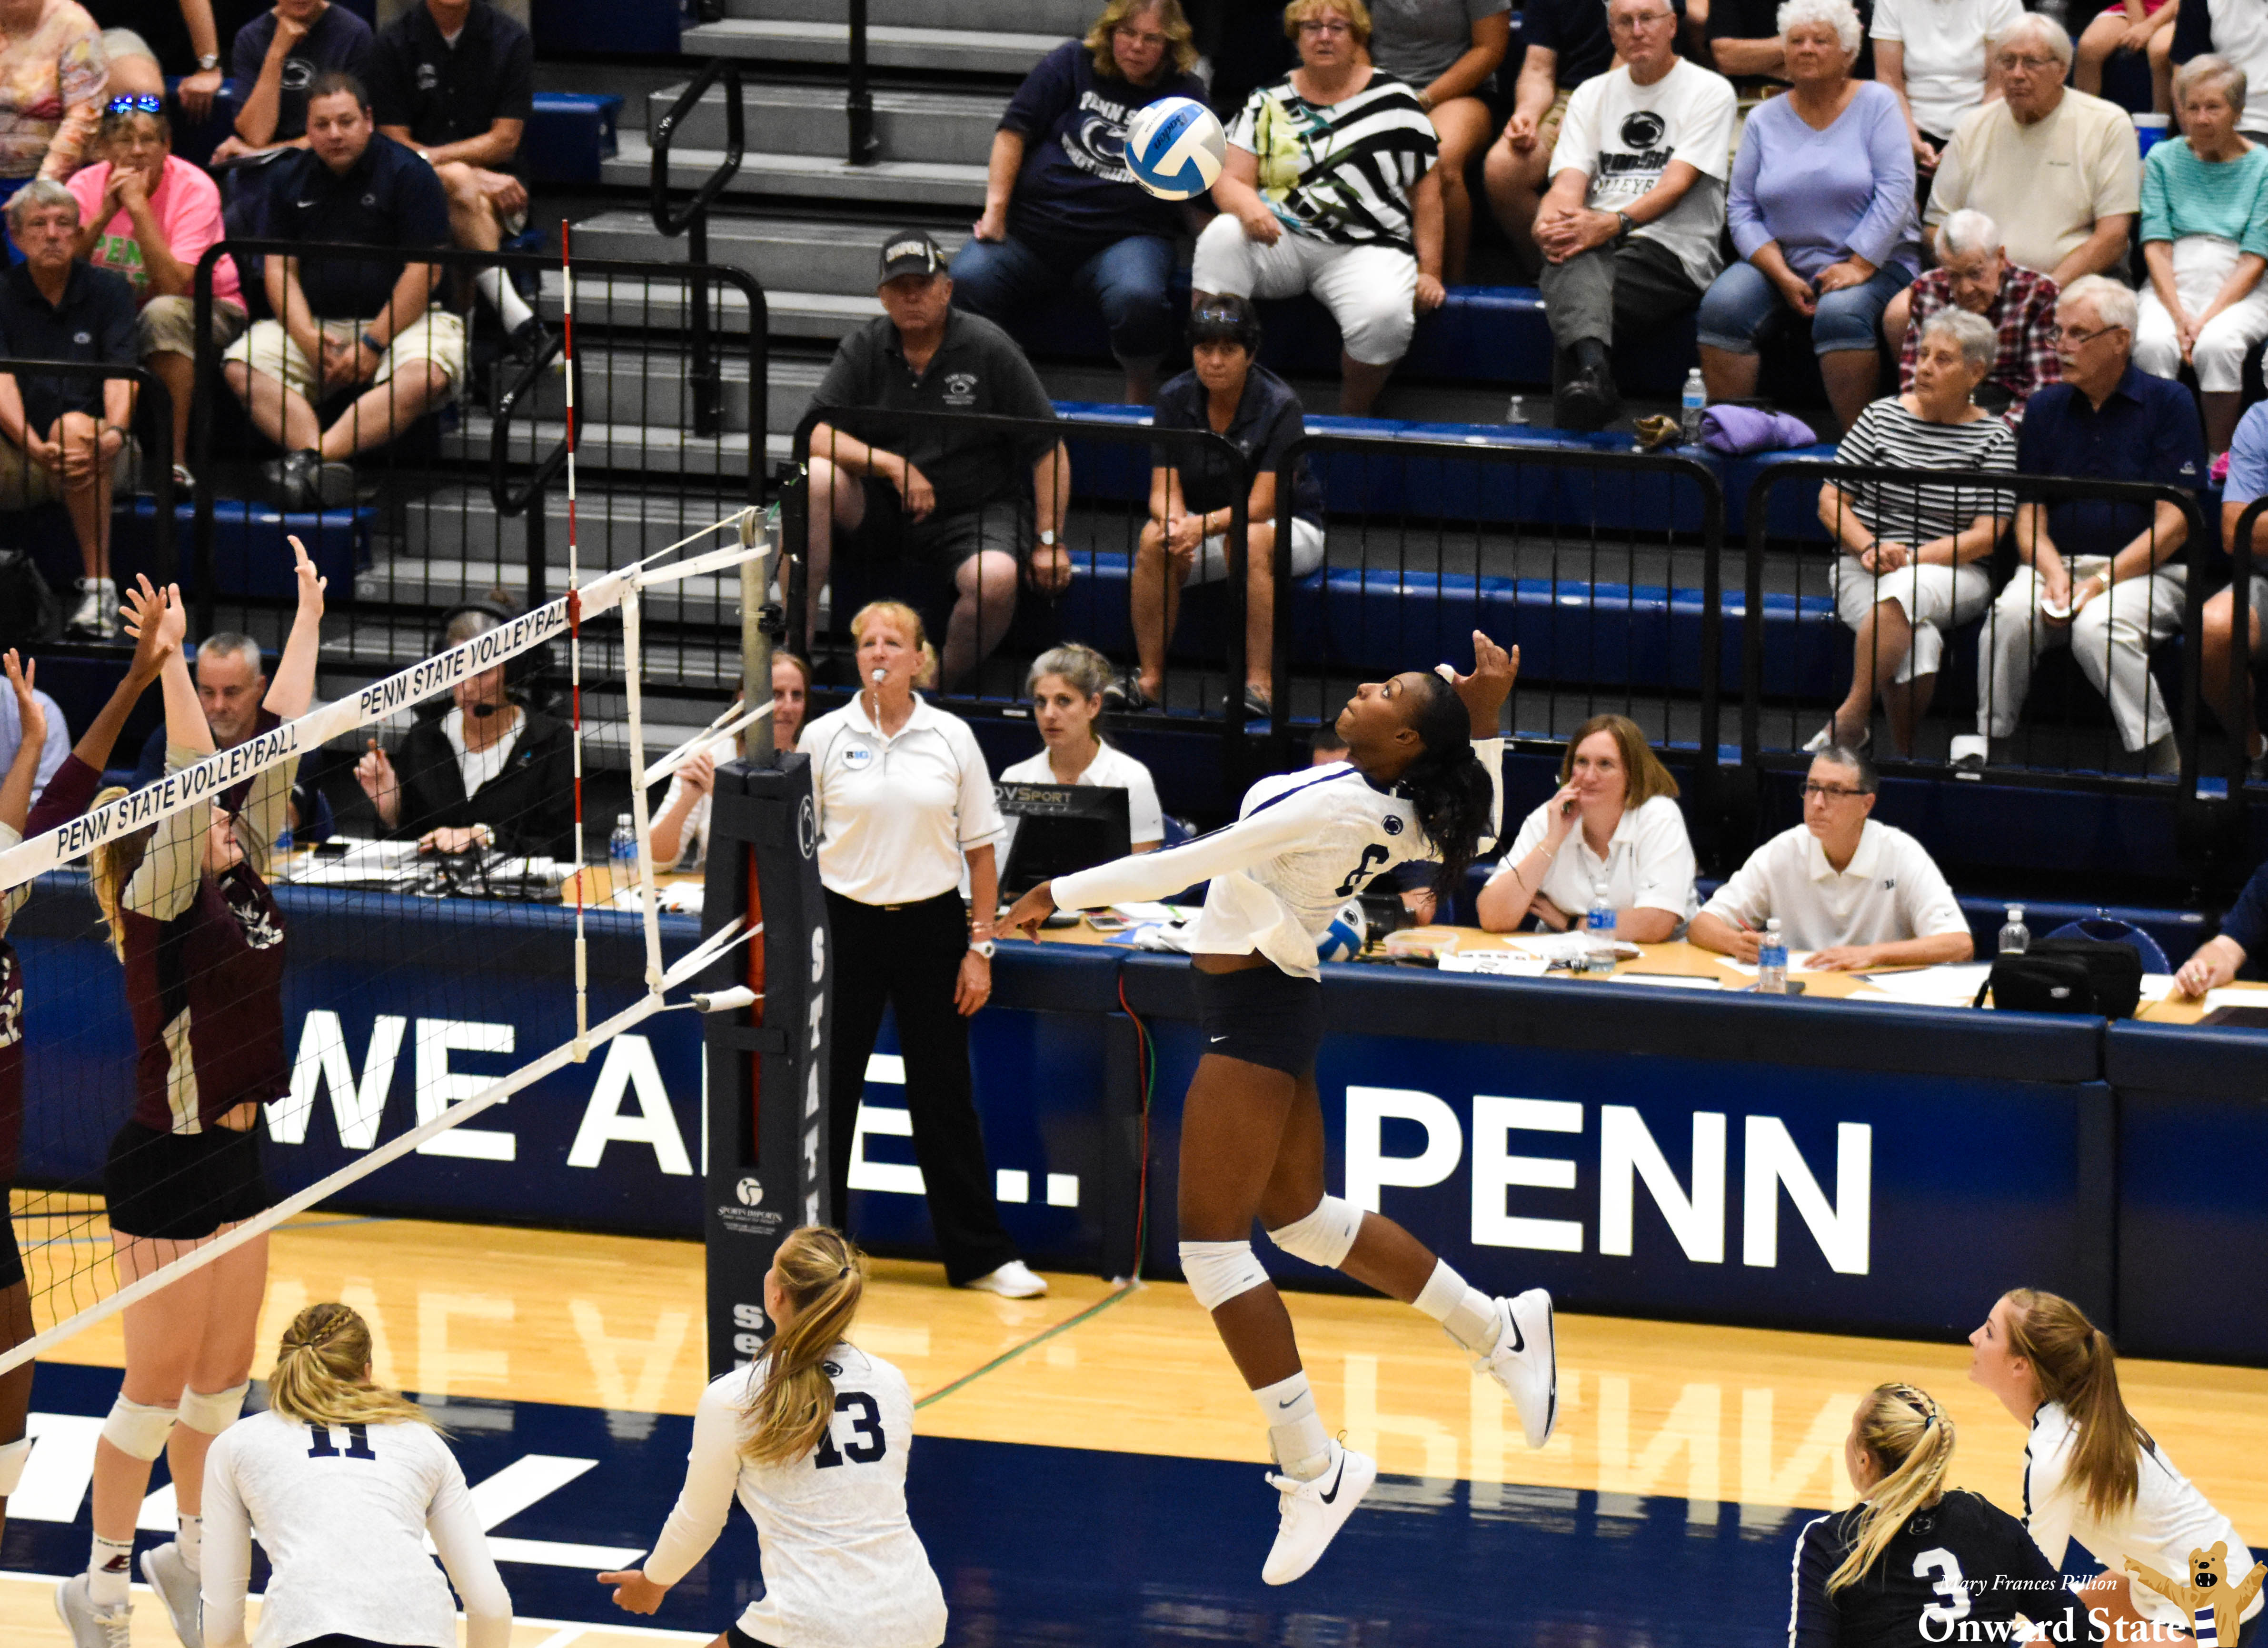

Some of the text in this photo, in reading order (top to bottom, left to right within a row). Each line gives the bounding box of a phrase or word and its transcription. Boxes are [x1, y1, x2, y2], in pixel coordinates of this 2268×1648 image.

[359, 675, 407, 719] PENN
[414, 649, 465, 696] STATE
[56, 725, 298, 859] PENN STATE VOLLEYBALL
[263, 1009, 517, 1161] WE
[1344, 1085, 1872, 1275] PENN
[814, 1391, 886, 1469] 13
[1912, 1548, 1971, 1623] 3
